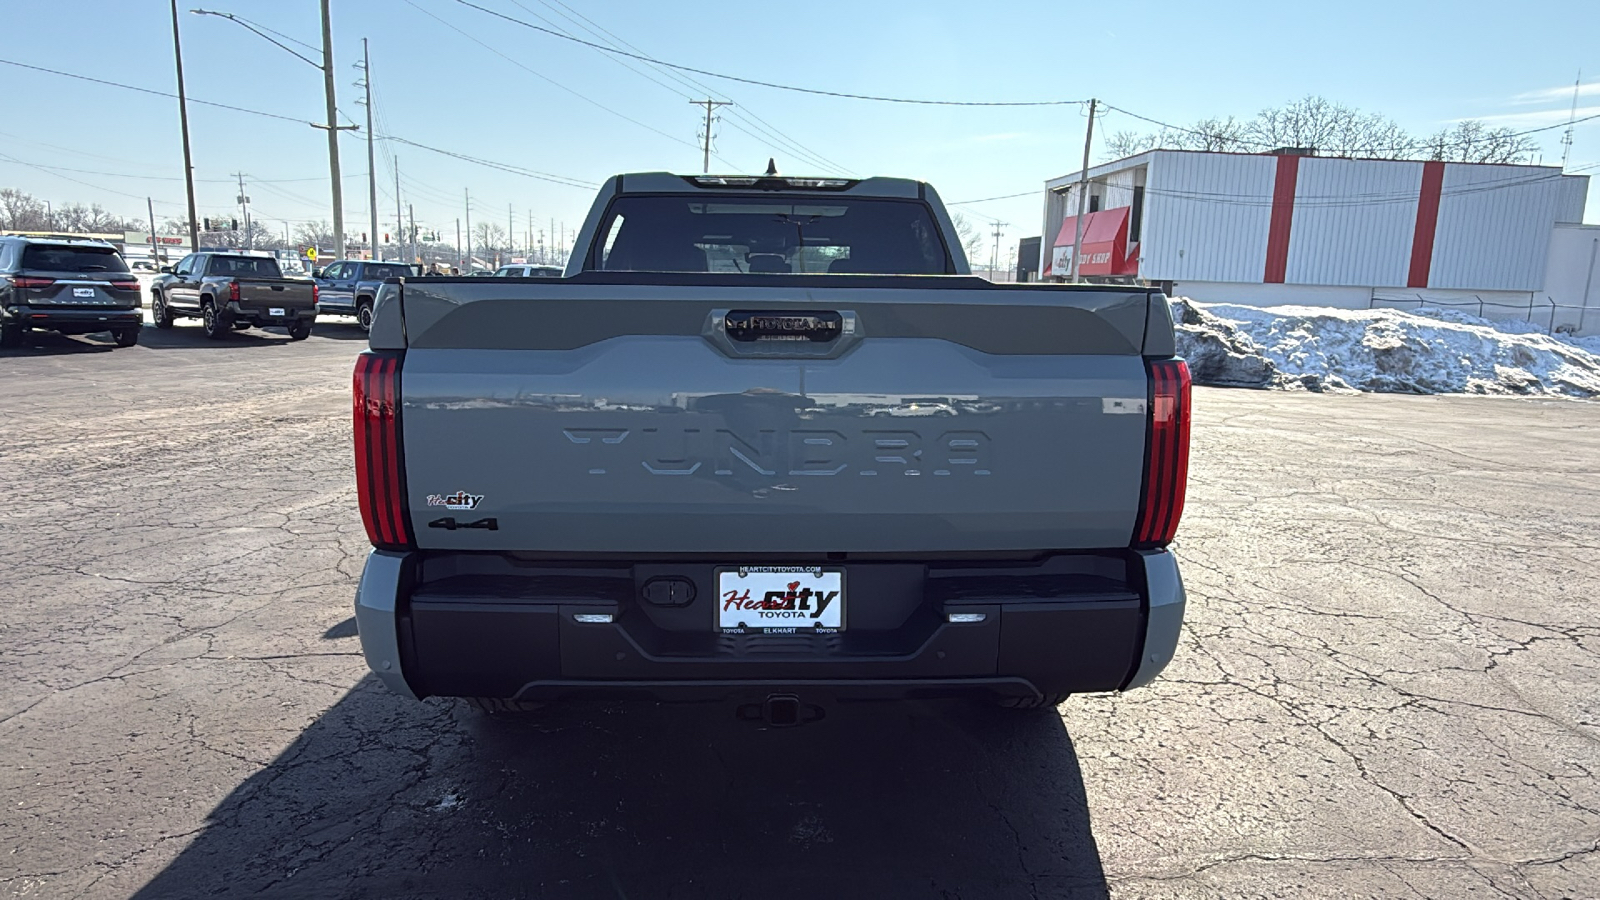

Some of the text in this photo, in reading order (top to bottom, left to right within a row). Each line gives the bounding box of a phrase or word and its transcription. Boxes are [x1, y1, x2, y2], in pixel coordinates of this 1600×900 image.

[1092, 252, 1110, 264] SHOP
[758, 317, 811, 331] TOYOTA
[563, 427, 993, 476] TUNDRA
[447, 492, 483, 509] city
[723, 583, 840, 618] Heart city
